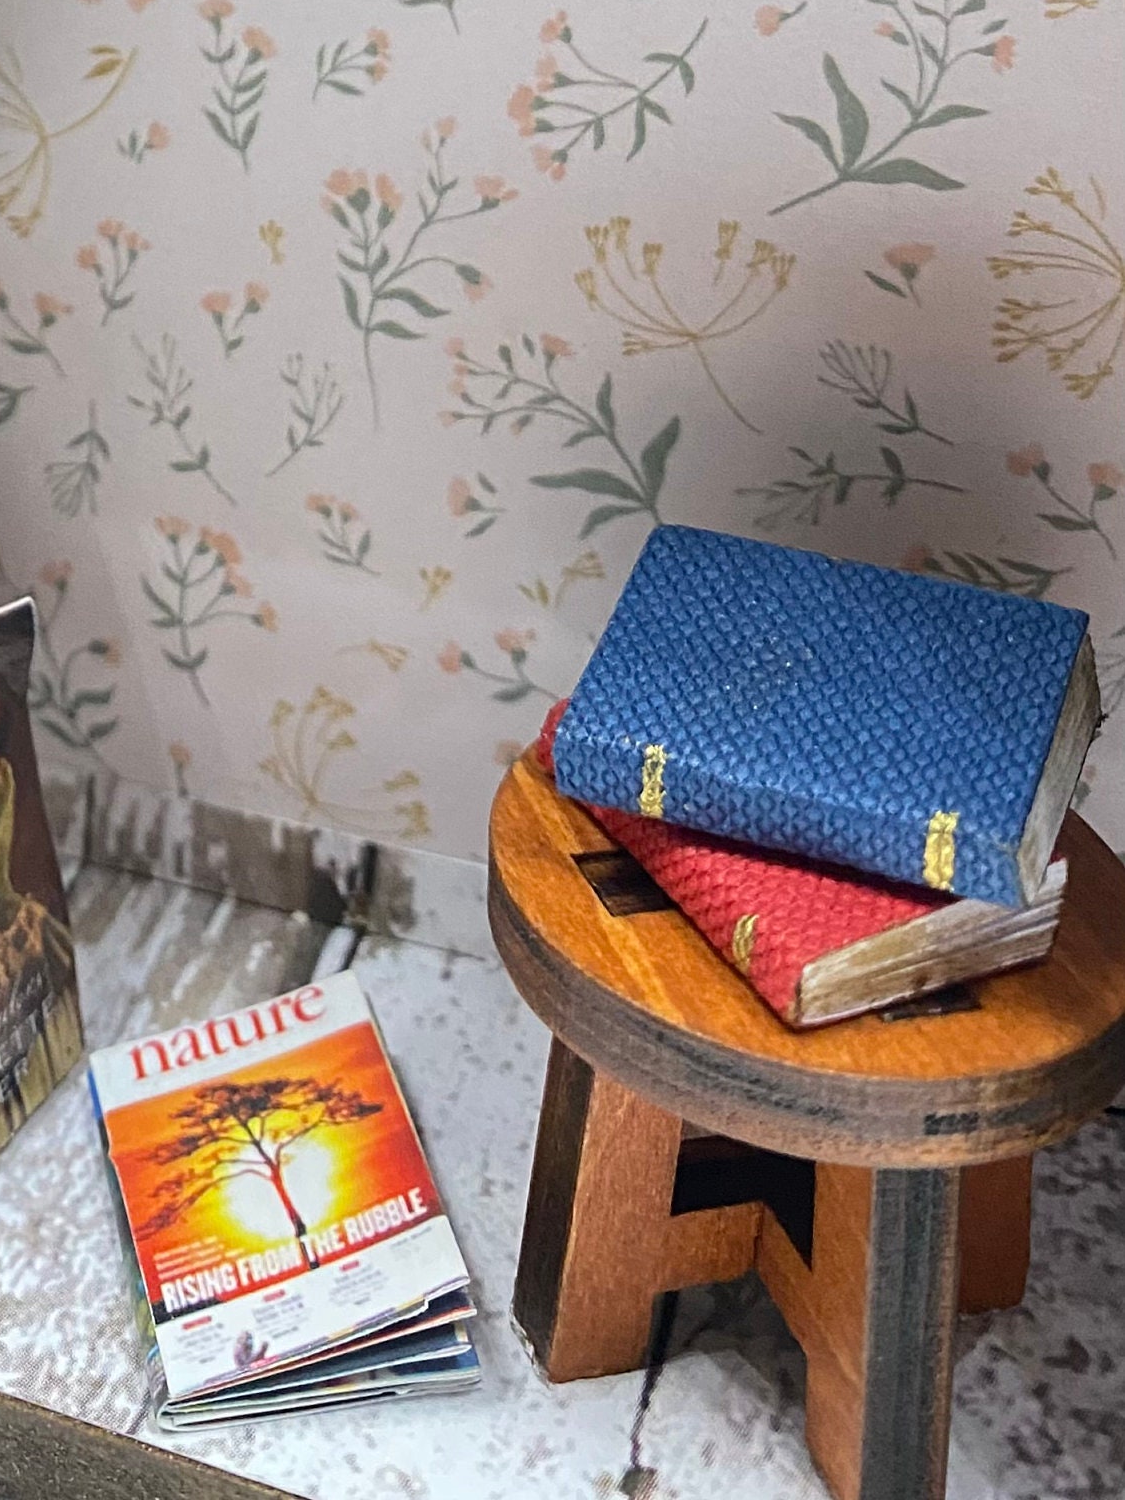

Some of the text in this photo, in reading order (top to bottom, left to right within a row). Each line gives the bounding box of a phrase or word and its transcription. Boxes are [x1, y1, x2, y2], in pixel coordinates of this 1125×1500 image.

[129, 985, 326, 1080] nature
[160, 1263, 238, 1314] RISING
[236, 1241, 301, 1287] FROM
[300, 1226, 346, 1264] THE
[344, 1187, 428, 1245] RUBBLE
